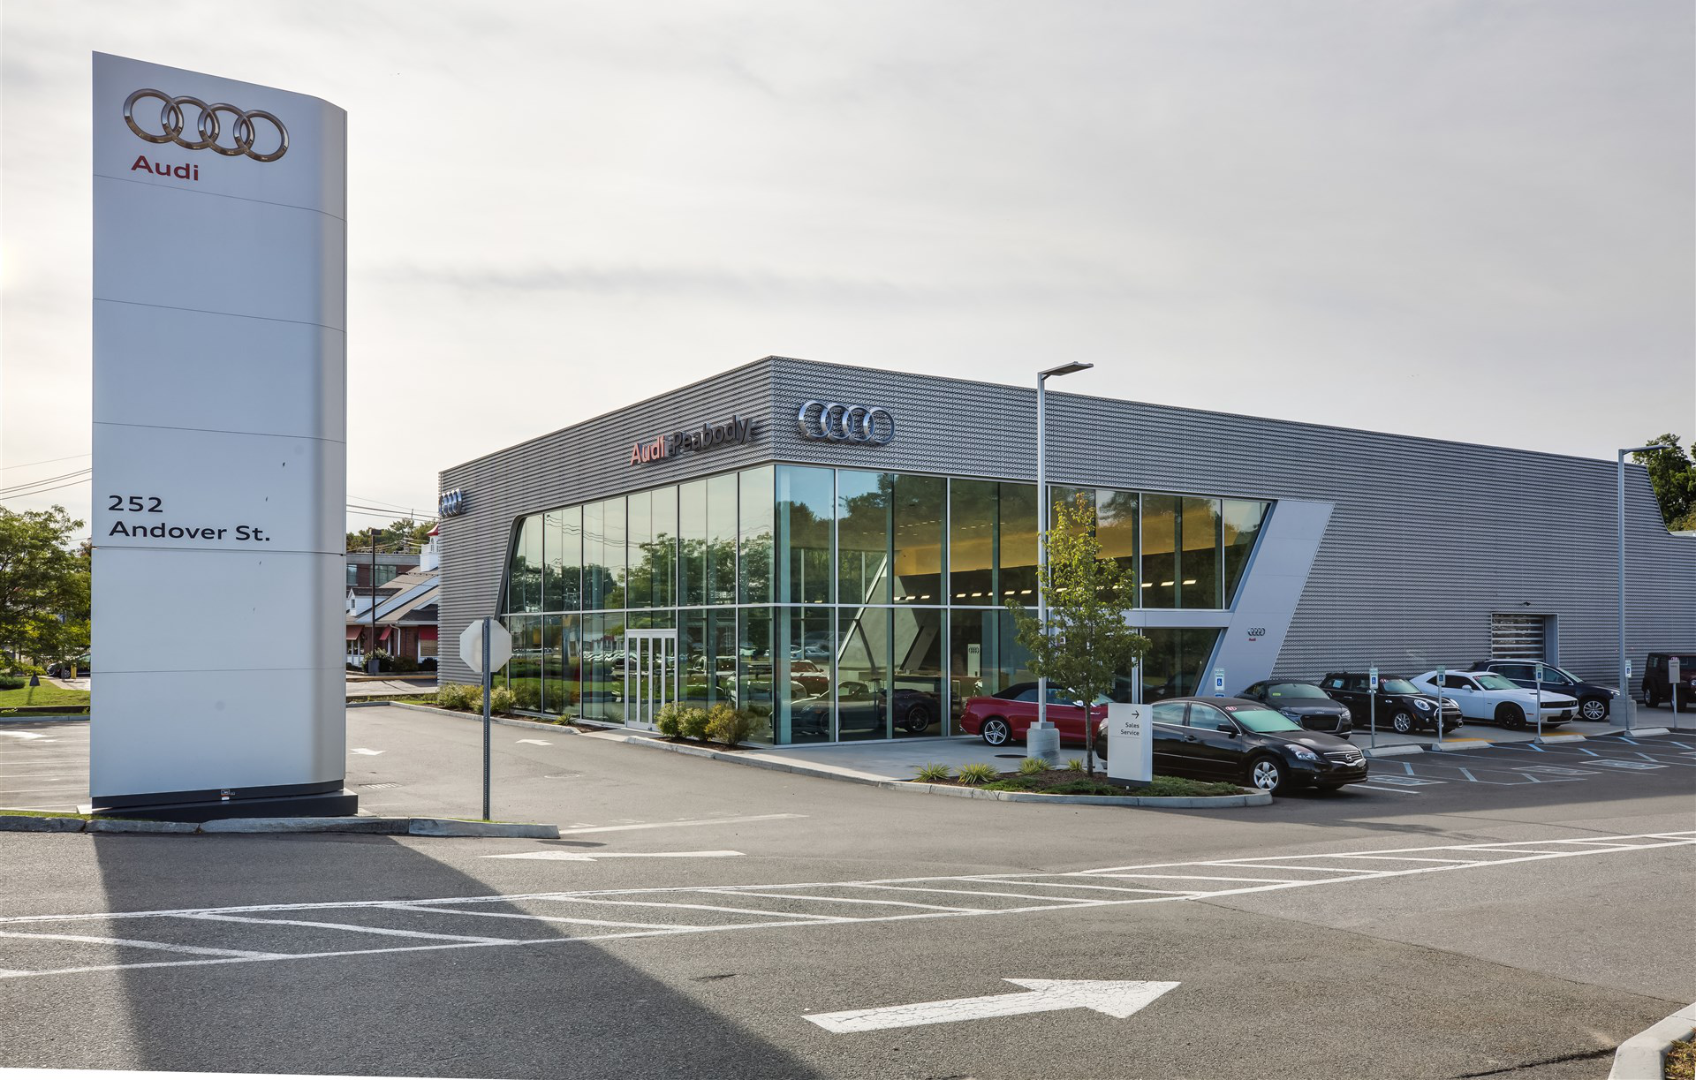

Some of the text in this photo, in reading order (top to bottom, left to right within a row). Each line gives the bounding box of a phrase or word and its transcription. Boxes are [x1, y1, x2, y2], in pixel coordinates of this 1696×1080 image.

[131, 155, 199, 181] Audi
[630, 415, 752, 466] Audi Peabody
[108, 495, 163, 513] 252
[109, 521, 270, 541] Andover St.
